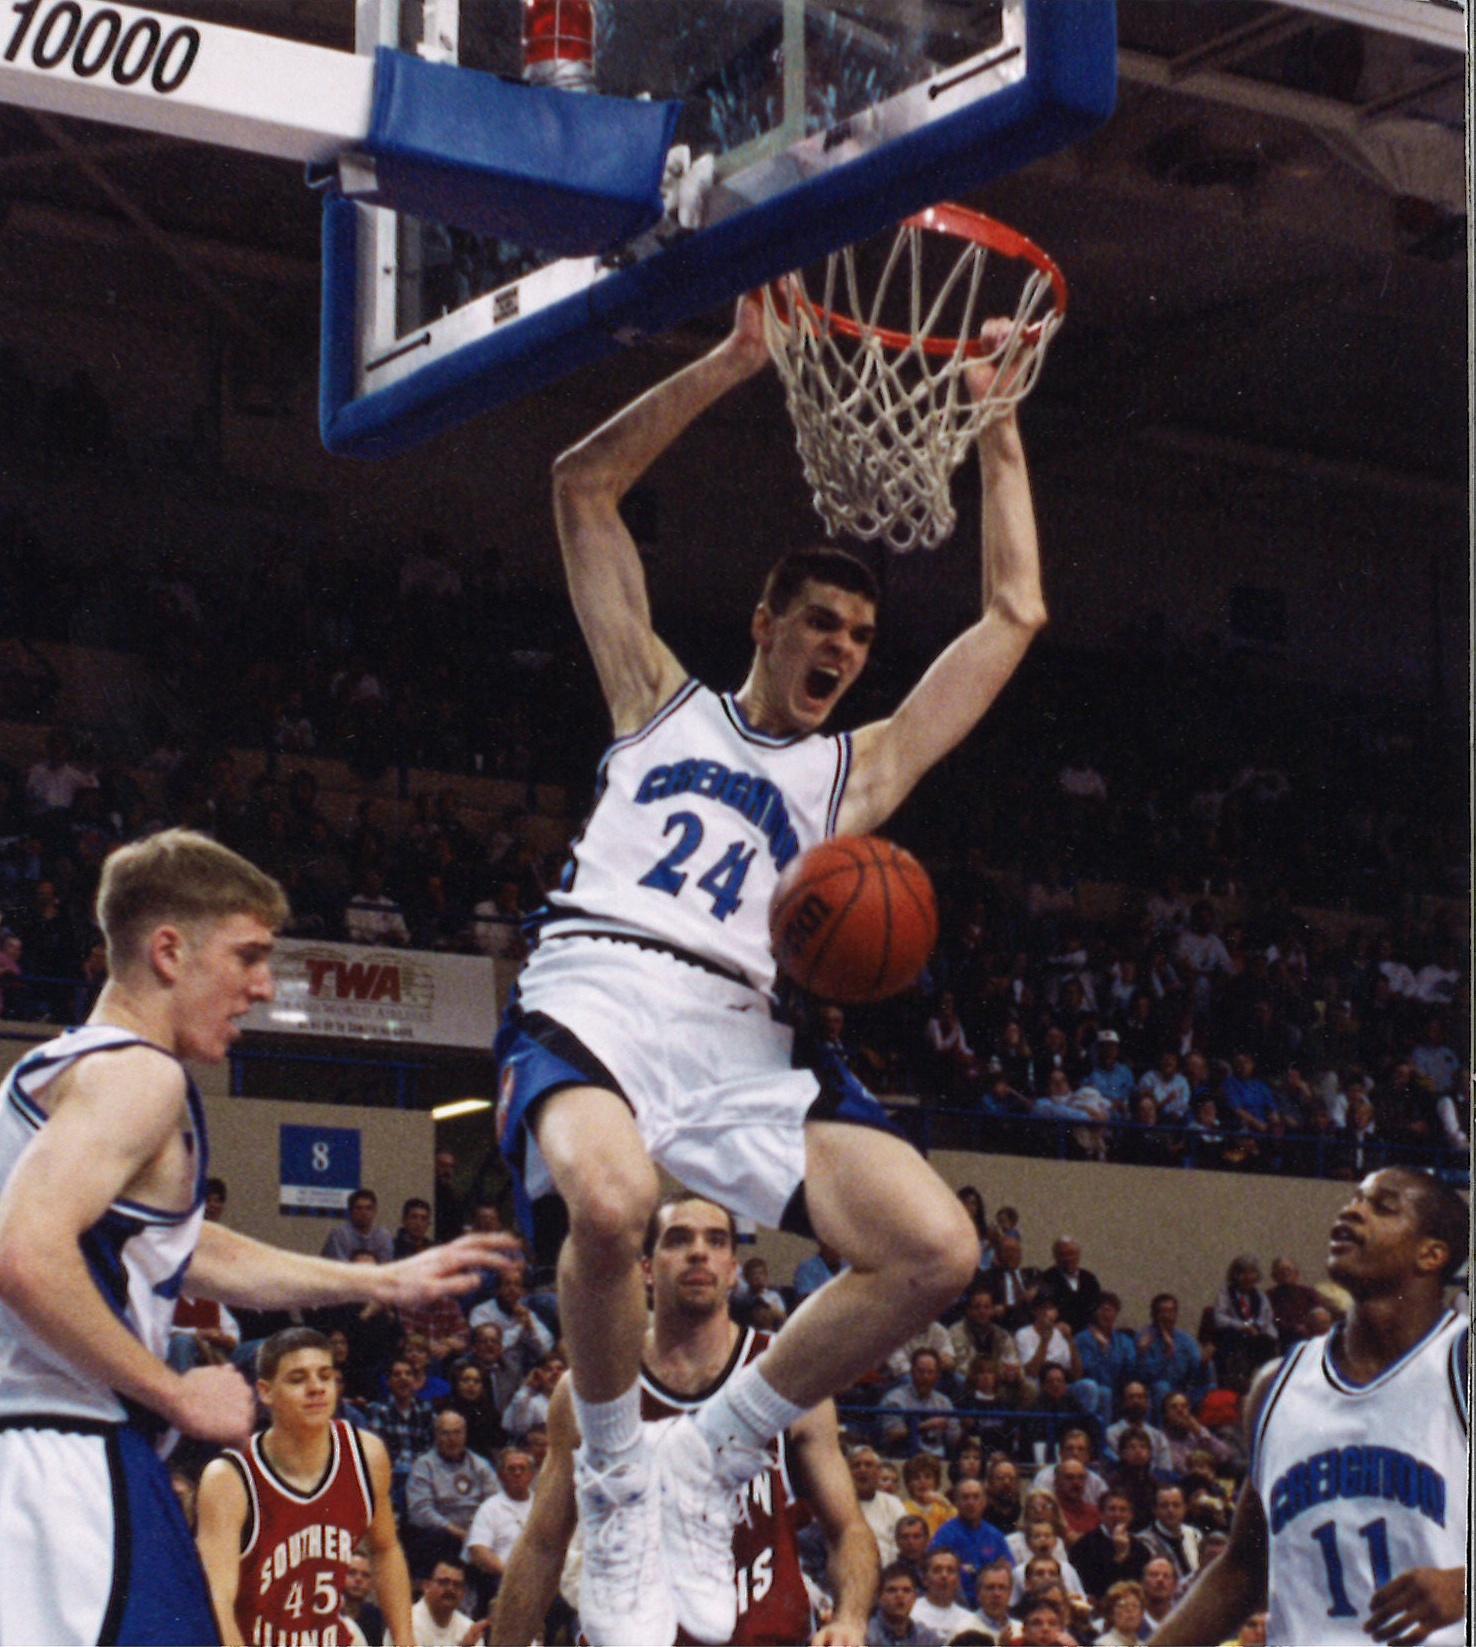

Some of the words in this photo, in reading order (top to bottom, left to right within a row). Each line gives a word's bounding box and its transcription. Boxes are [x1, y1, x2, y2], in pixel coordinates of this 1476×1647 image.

[3, 0, 200, 94] 10000
[637, 811, 757, 922] 24
[305, 959, 401, 1002] TWA
[312, 1142, 329, 1171] 8
[1270, 1445, 1446, 1536] CREIGHTON
[284, 1571, 338, 1618] 45
[1311, 1517, 1392, 1617] 11
